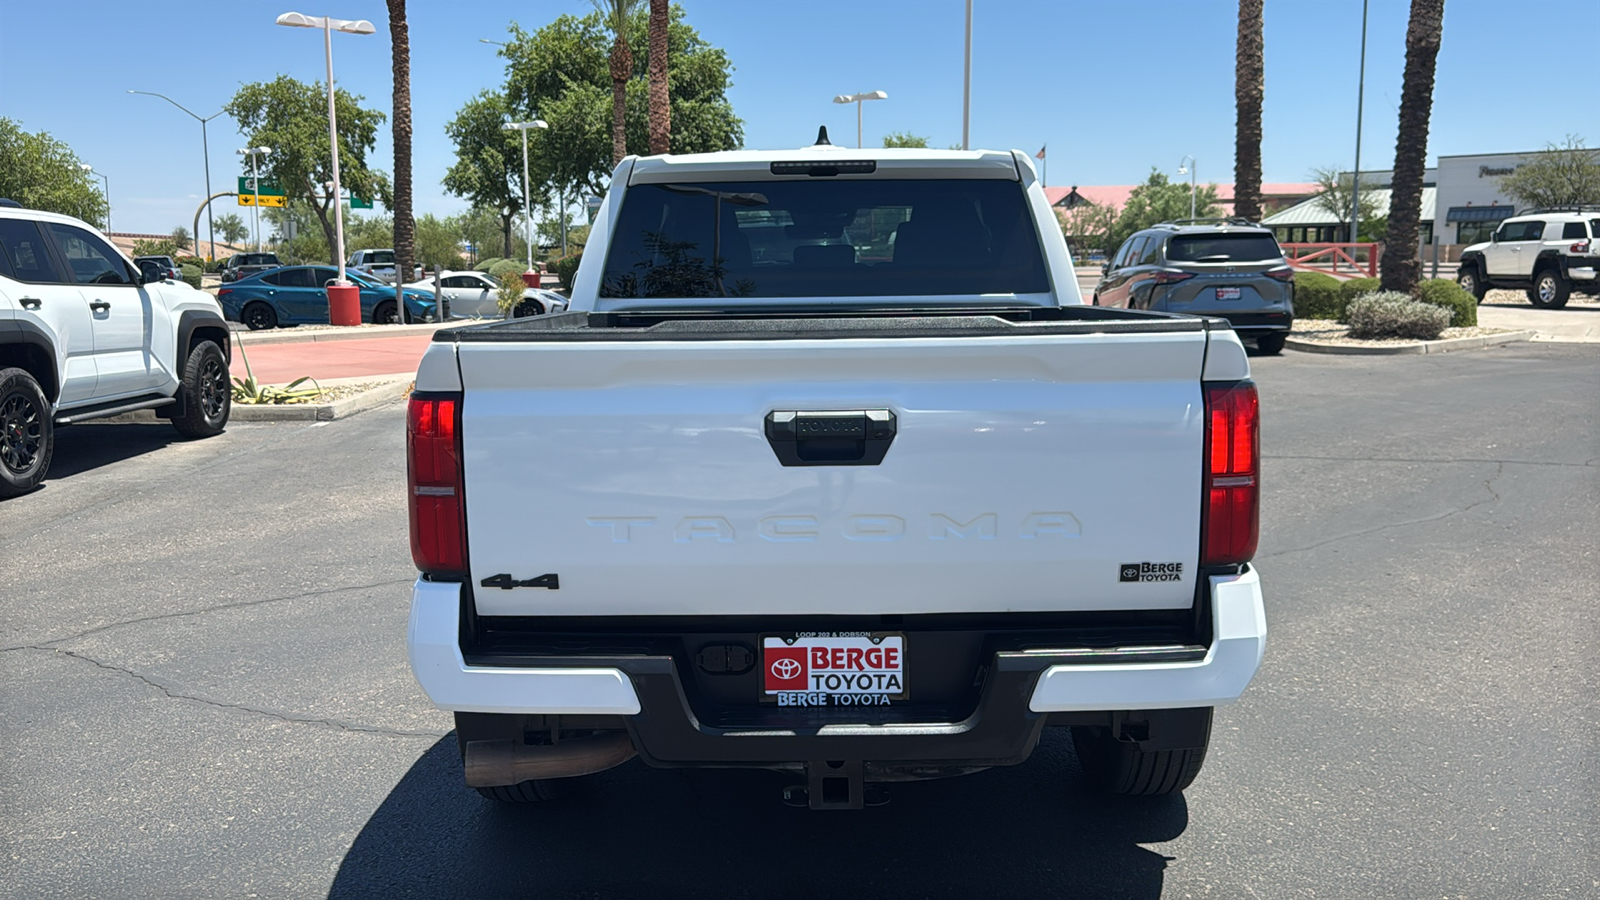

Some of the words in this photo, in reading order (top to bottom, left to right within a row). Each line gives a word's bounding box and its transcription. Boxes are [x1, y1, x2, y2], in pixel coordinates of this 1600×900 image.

[586, 511, 1082, 543] TACOMA
[1141, 562, 1183, 573] BERGE
[1141, 574, 1181, 582] TOYOTA
[811, 647, 900, 671] BERGE
[811, 674, 902, 690] TOYOTA
[778, 692, 827, 707] BERGE
[832, 694, 891, 706] TOYOTA
